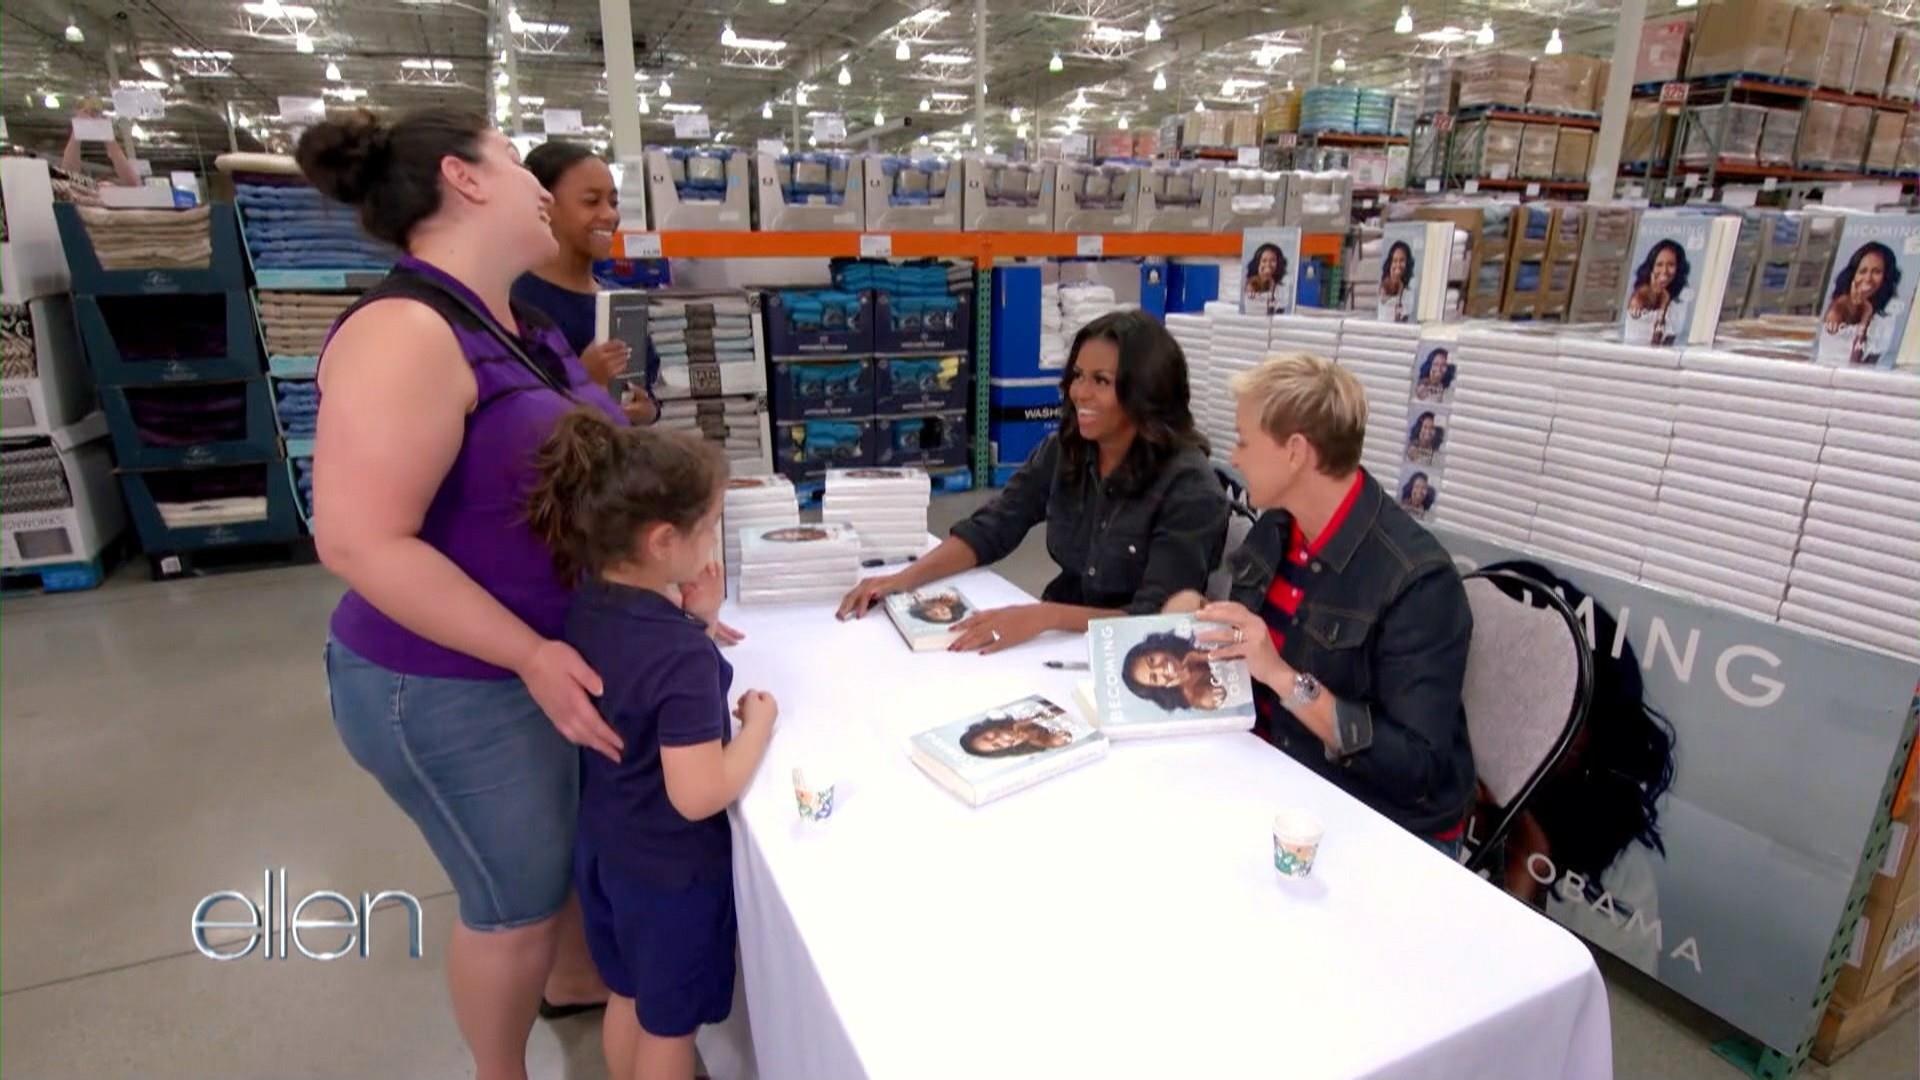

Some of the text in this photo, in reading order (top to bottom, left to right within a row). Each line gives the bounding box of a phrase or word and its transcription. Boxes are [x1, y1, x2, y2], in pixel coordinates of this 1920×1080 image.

[1024, 407, 1063, 420] WASH
[1101, 625, 1122, 722] BECOMING
[1527, 852, 1702, 974] OBAMA
